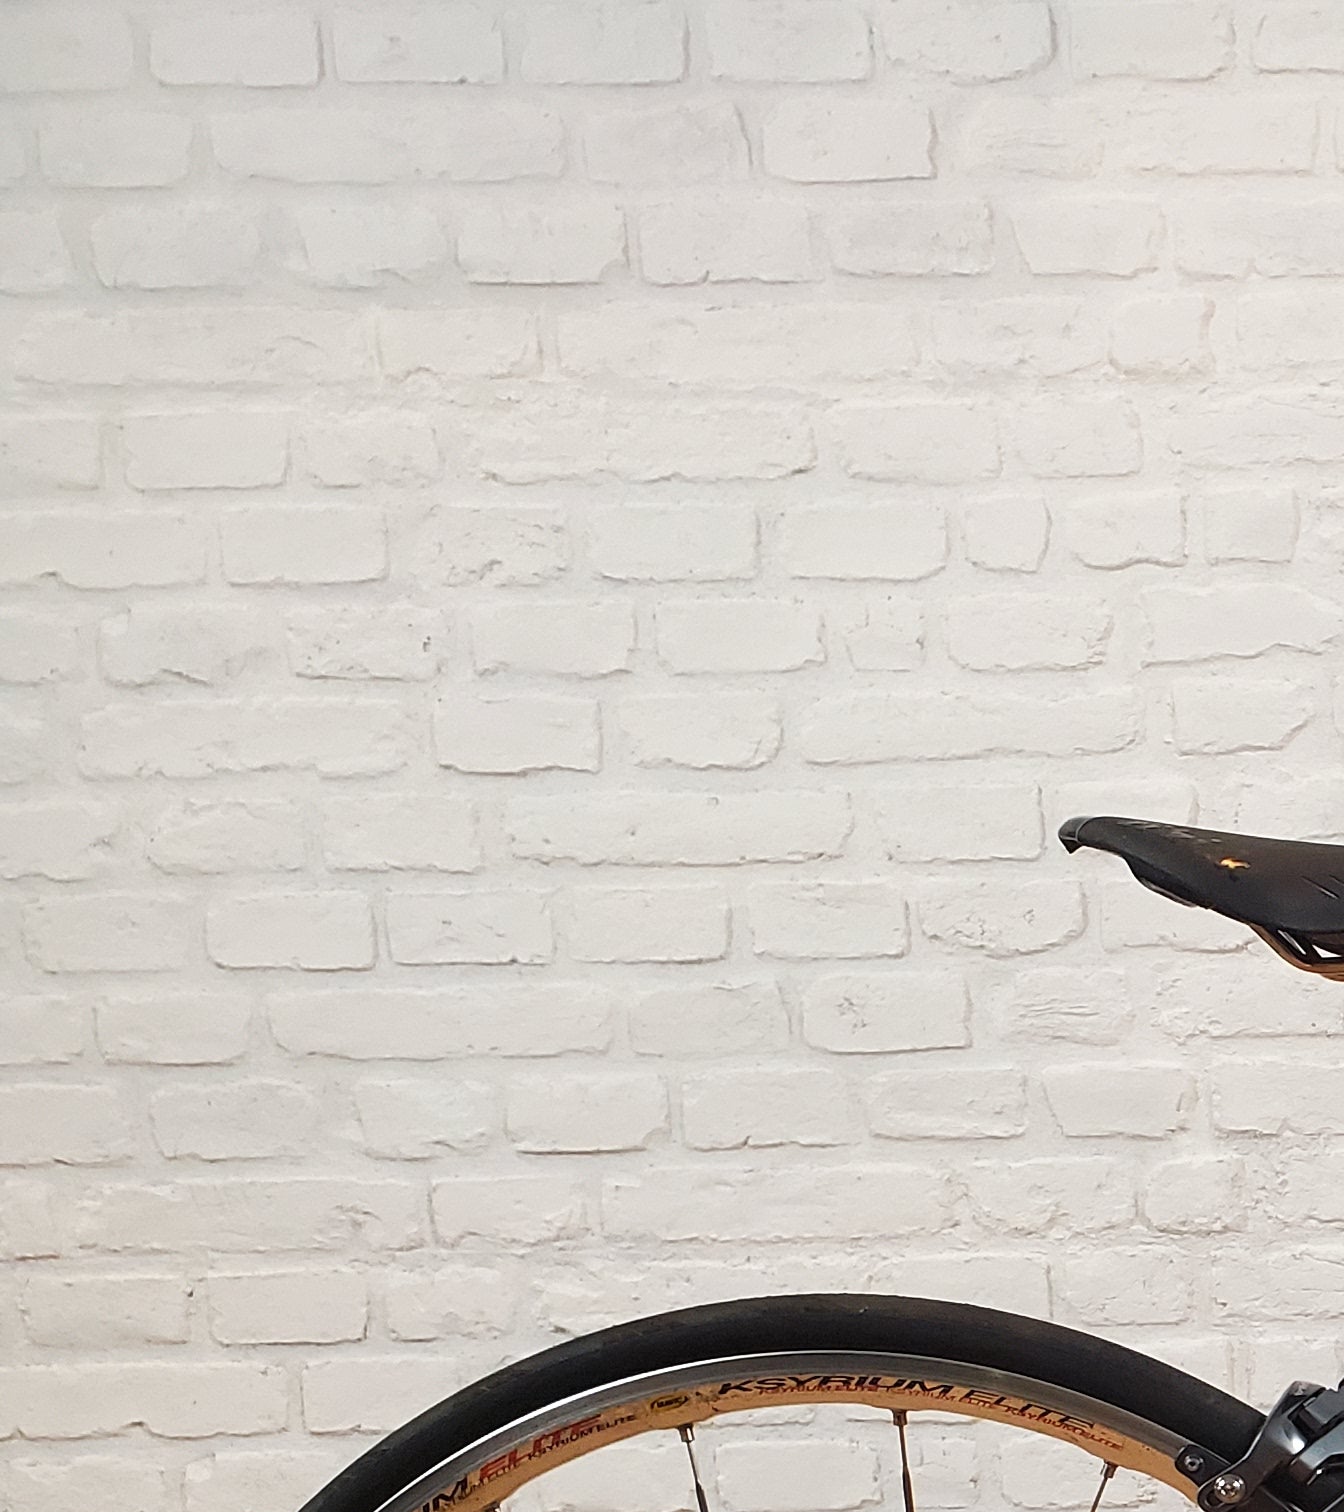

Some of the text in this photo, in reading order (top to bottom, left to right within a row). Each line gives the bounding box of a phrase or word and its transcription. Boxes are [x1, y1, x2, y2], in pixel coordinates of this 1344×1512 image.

[716, 1375, 1094, 1433] KSYRIUM ELITE
[474, 1412, 604, 1480] ELITE
